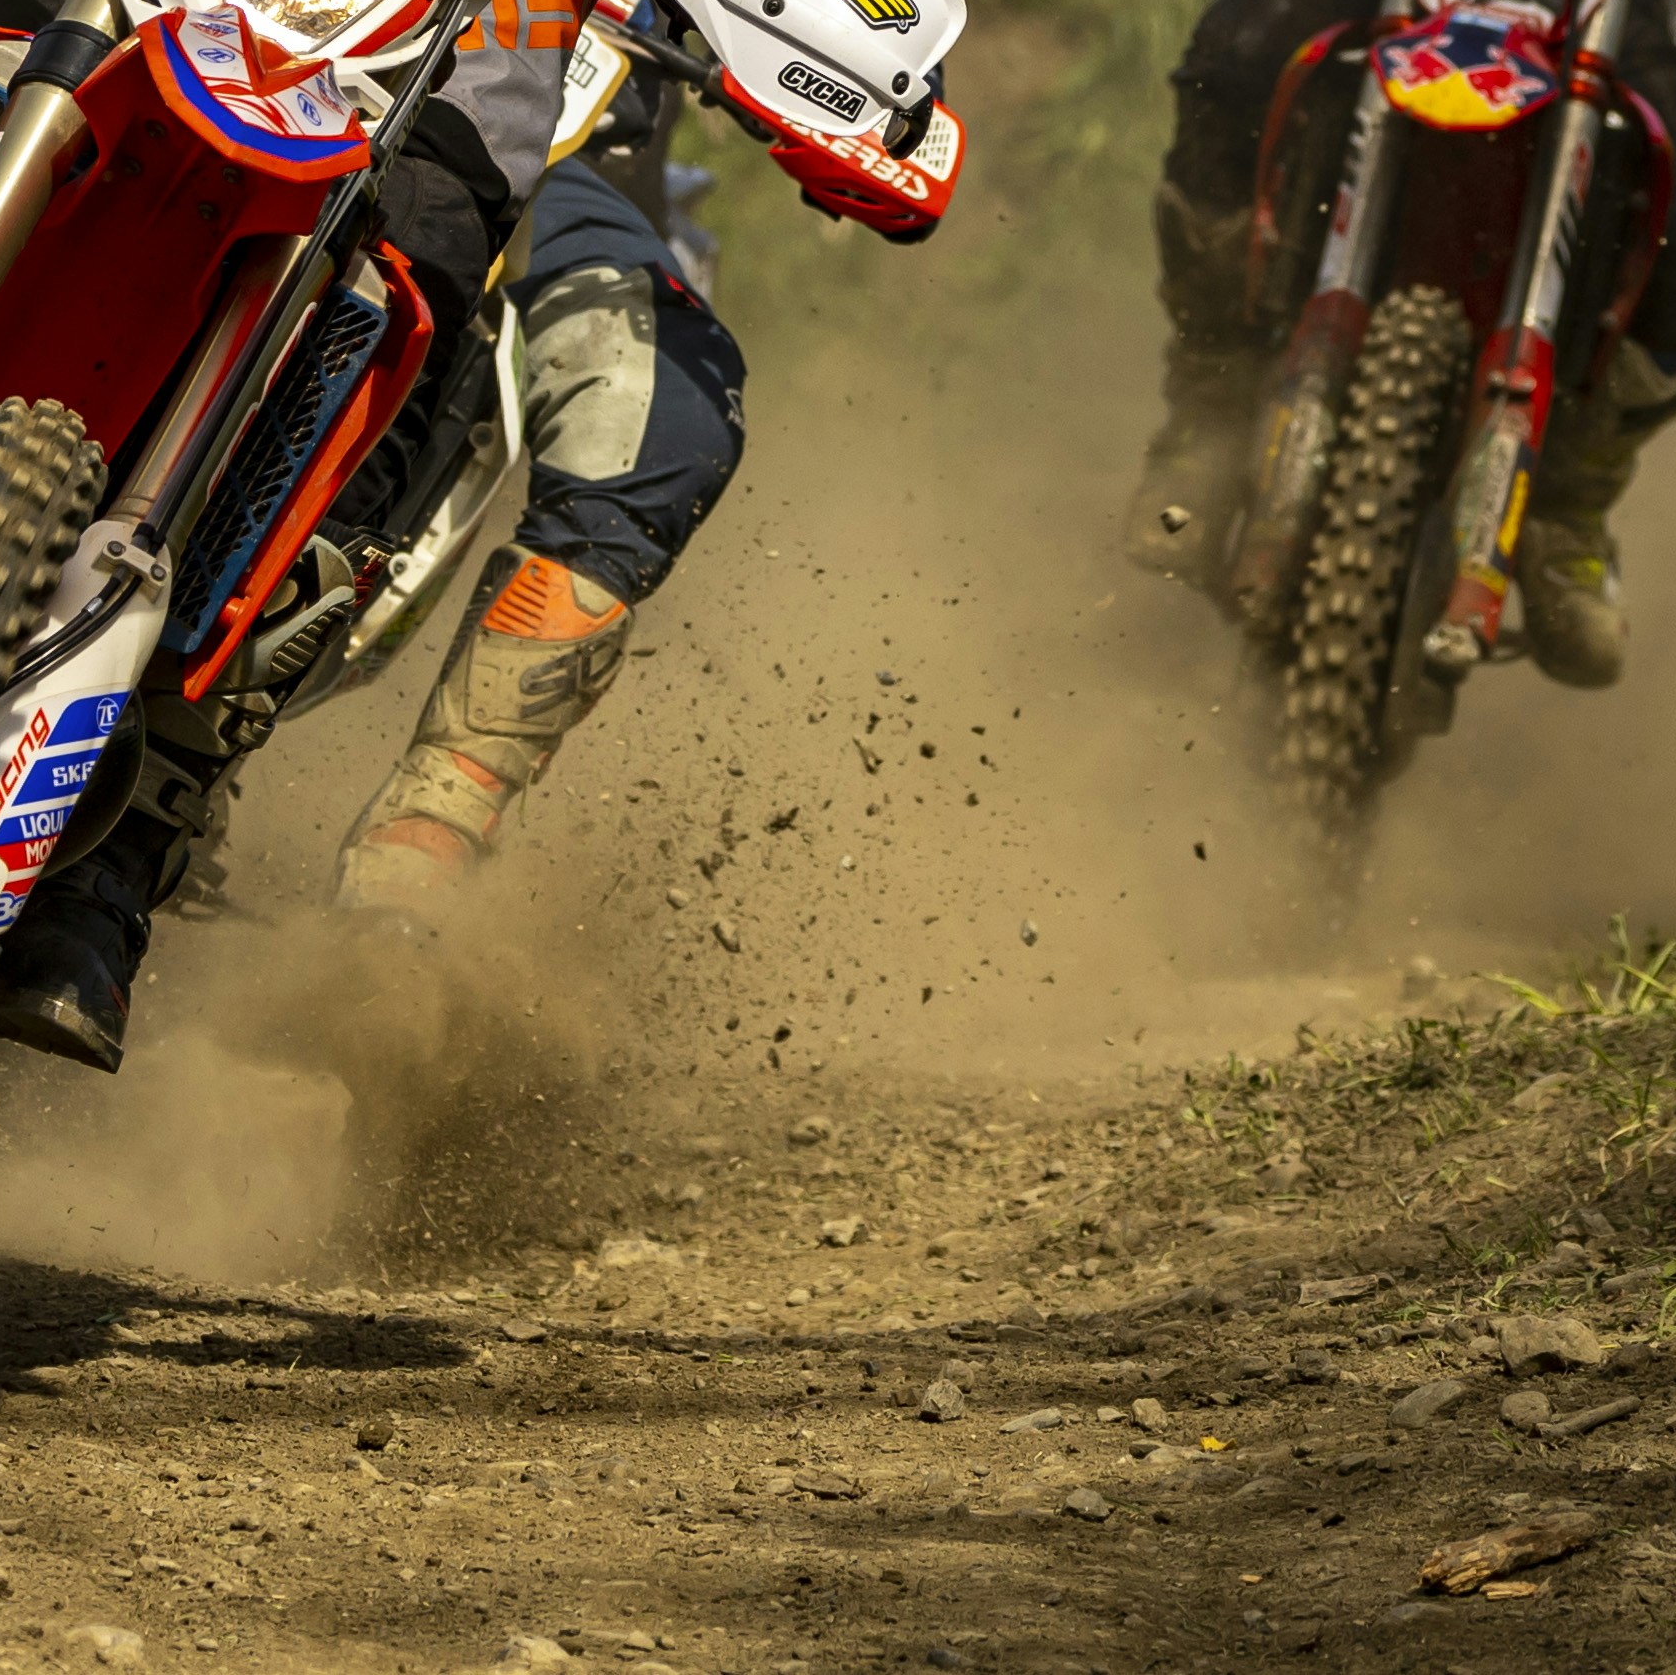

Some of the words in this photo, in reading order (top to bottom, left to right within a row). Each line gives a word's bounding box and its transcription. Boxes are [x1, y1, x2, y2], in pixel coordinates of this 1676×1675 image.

[783, 66, 863, 117] CYCRA
[98, 702, 119, 728] ZF
[19, 810, 65, 839] LIQUI
